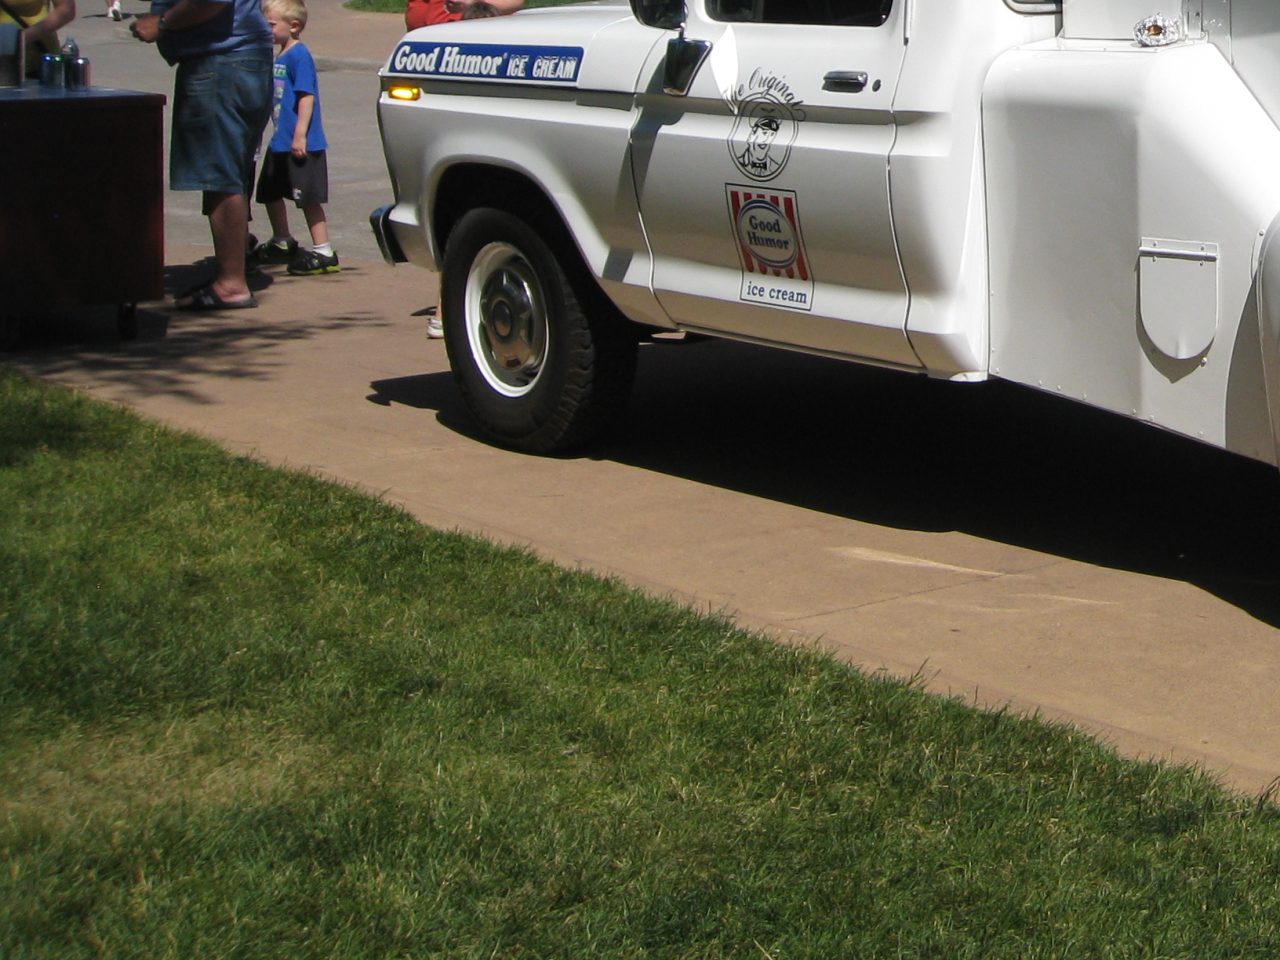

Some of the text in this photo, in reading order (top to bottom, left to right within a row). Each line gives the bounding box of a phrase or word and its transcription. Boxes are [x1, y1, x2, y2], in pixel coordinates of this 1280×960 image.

[394, 44, 440, 72] Good
[506, 54, 530, 77] ICE
[532, 55, 578, 79] CREAM
[748, 215, 782, 234] Good
[747, 231, 790, 250] Humor
[747, 281, 807, 304] ice cream
